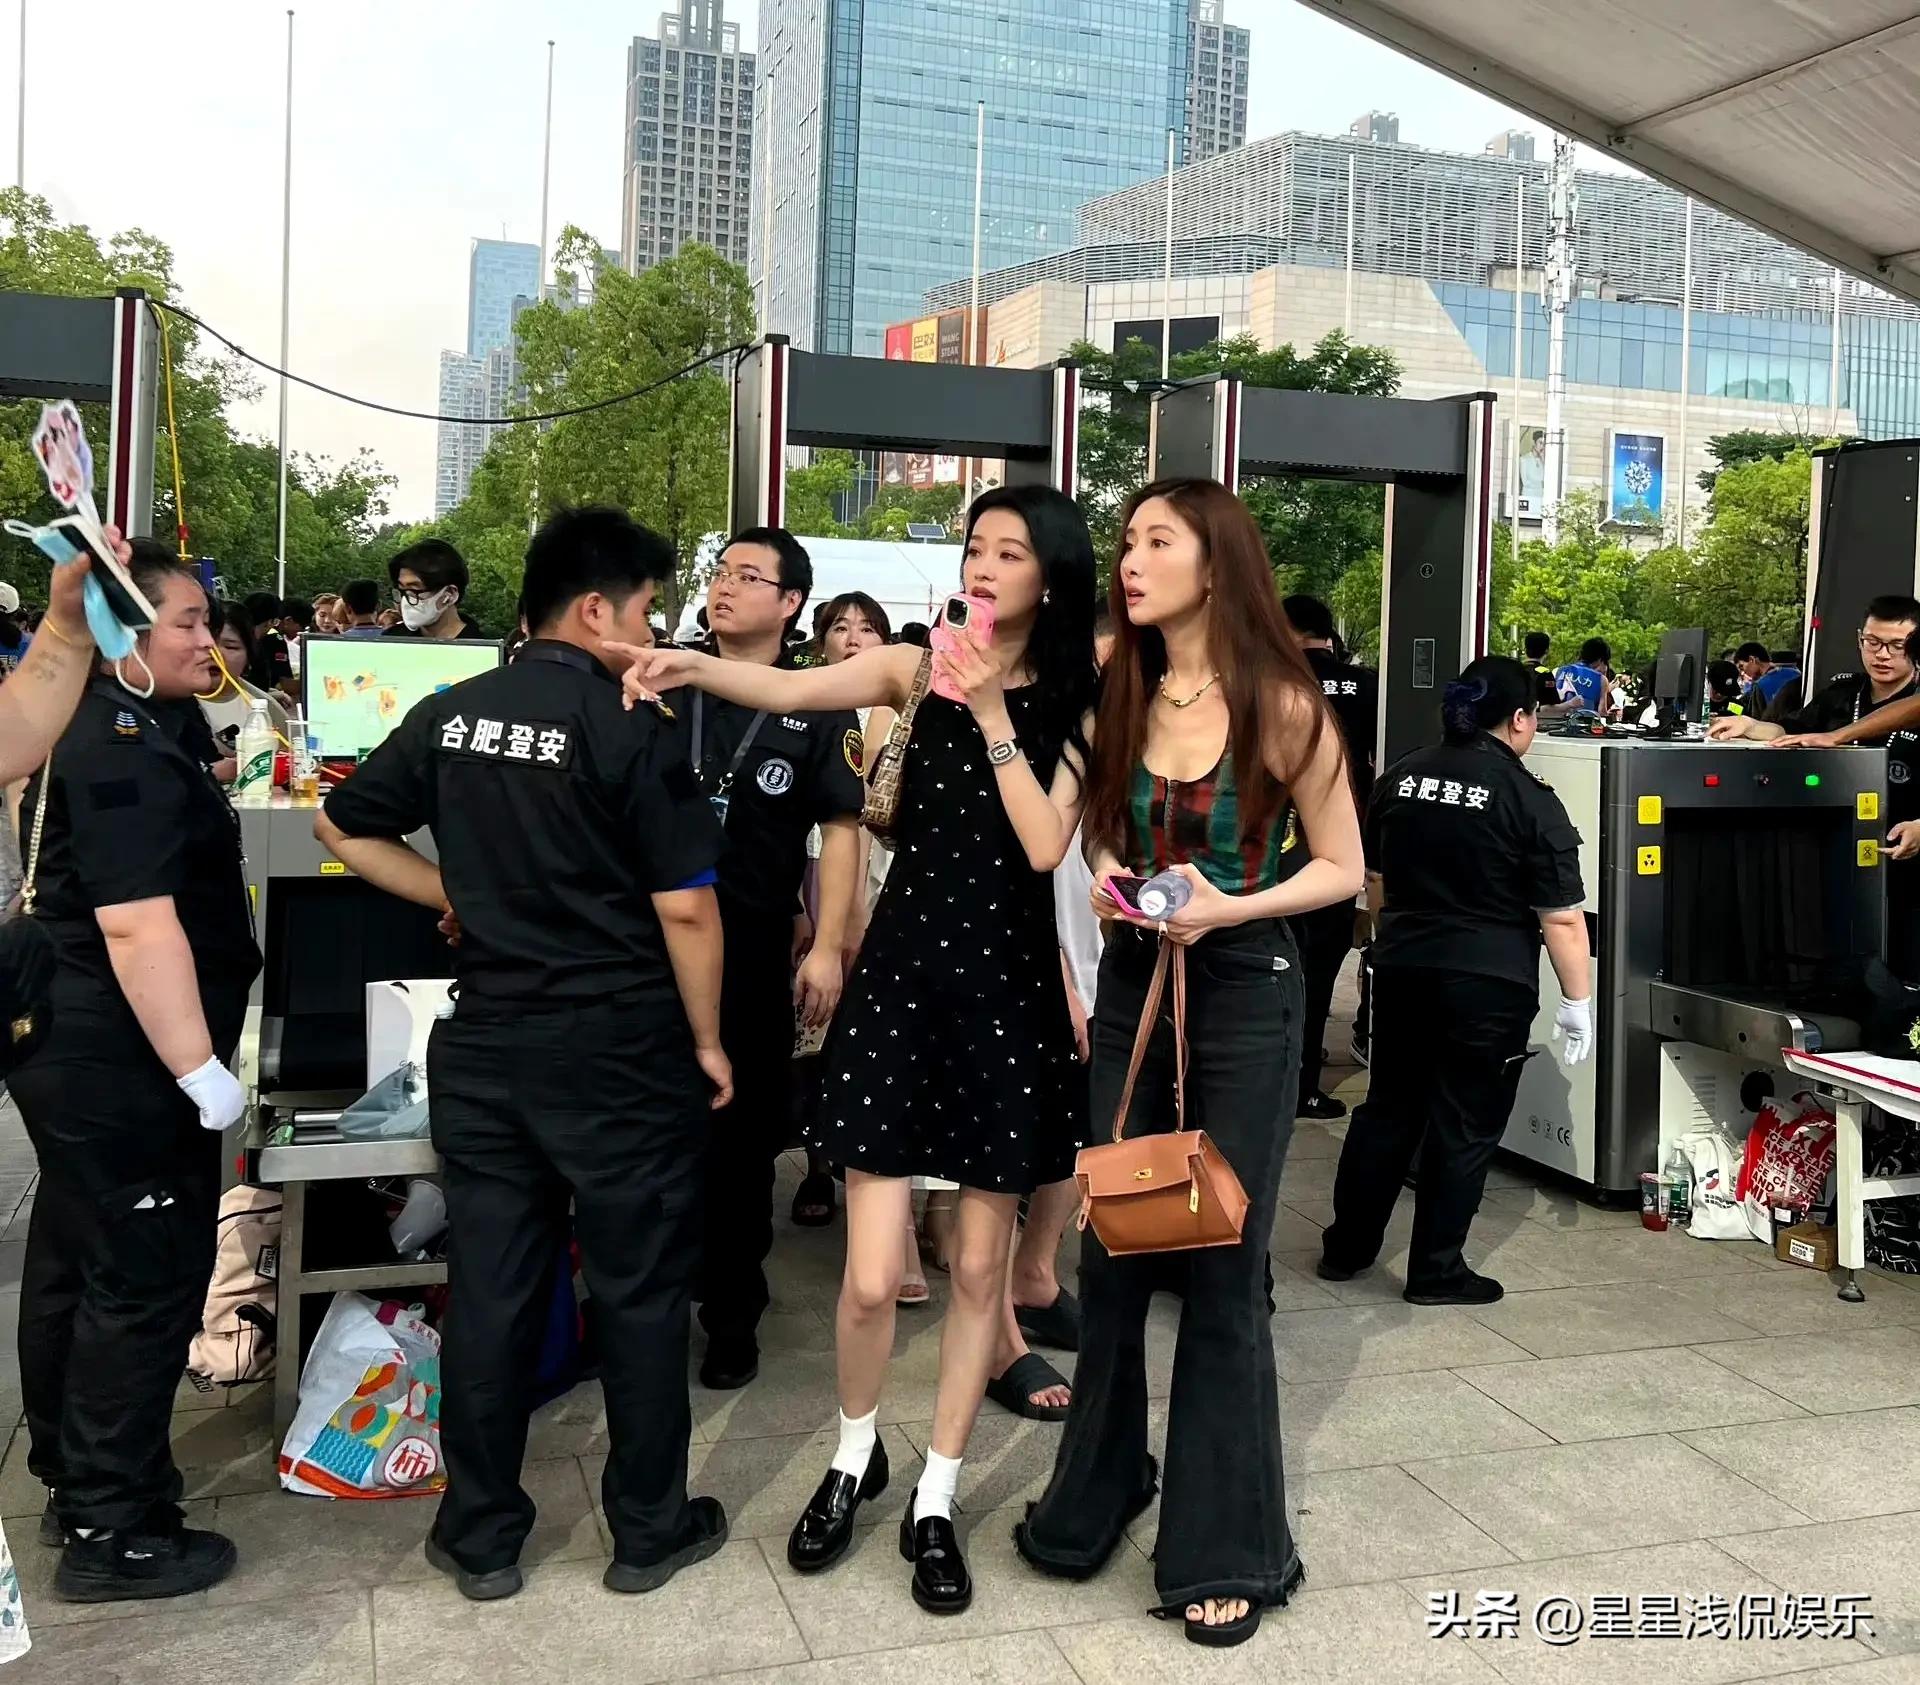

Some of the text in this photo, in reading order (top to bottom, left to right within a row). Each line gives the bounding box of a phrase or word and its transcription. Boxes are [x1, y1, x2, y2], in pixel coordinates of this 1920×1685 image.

[1322, 680, 1358, 695] 登安
[441, 714, 567, 764] 合肥登安
[1398, 775, 1490, 810] 合肥登安
[1752, 1170, 1775, 1193] AND
